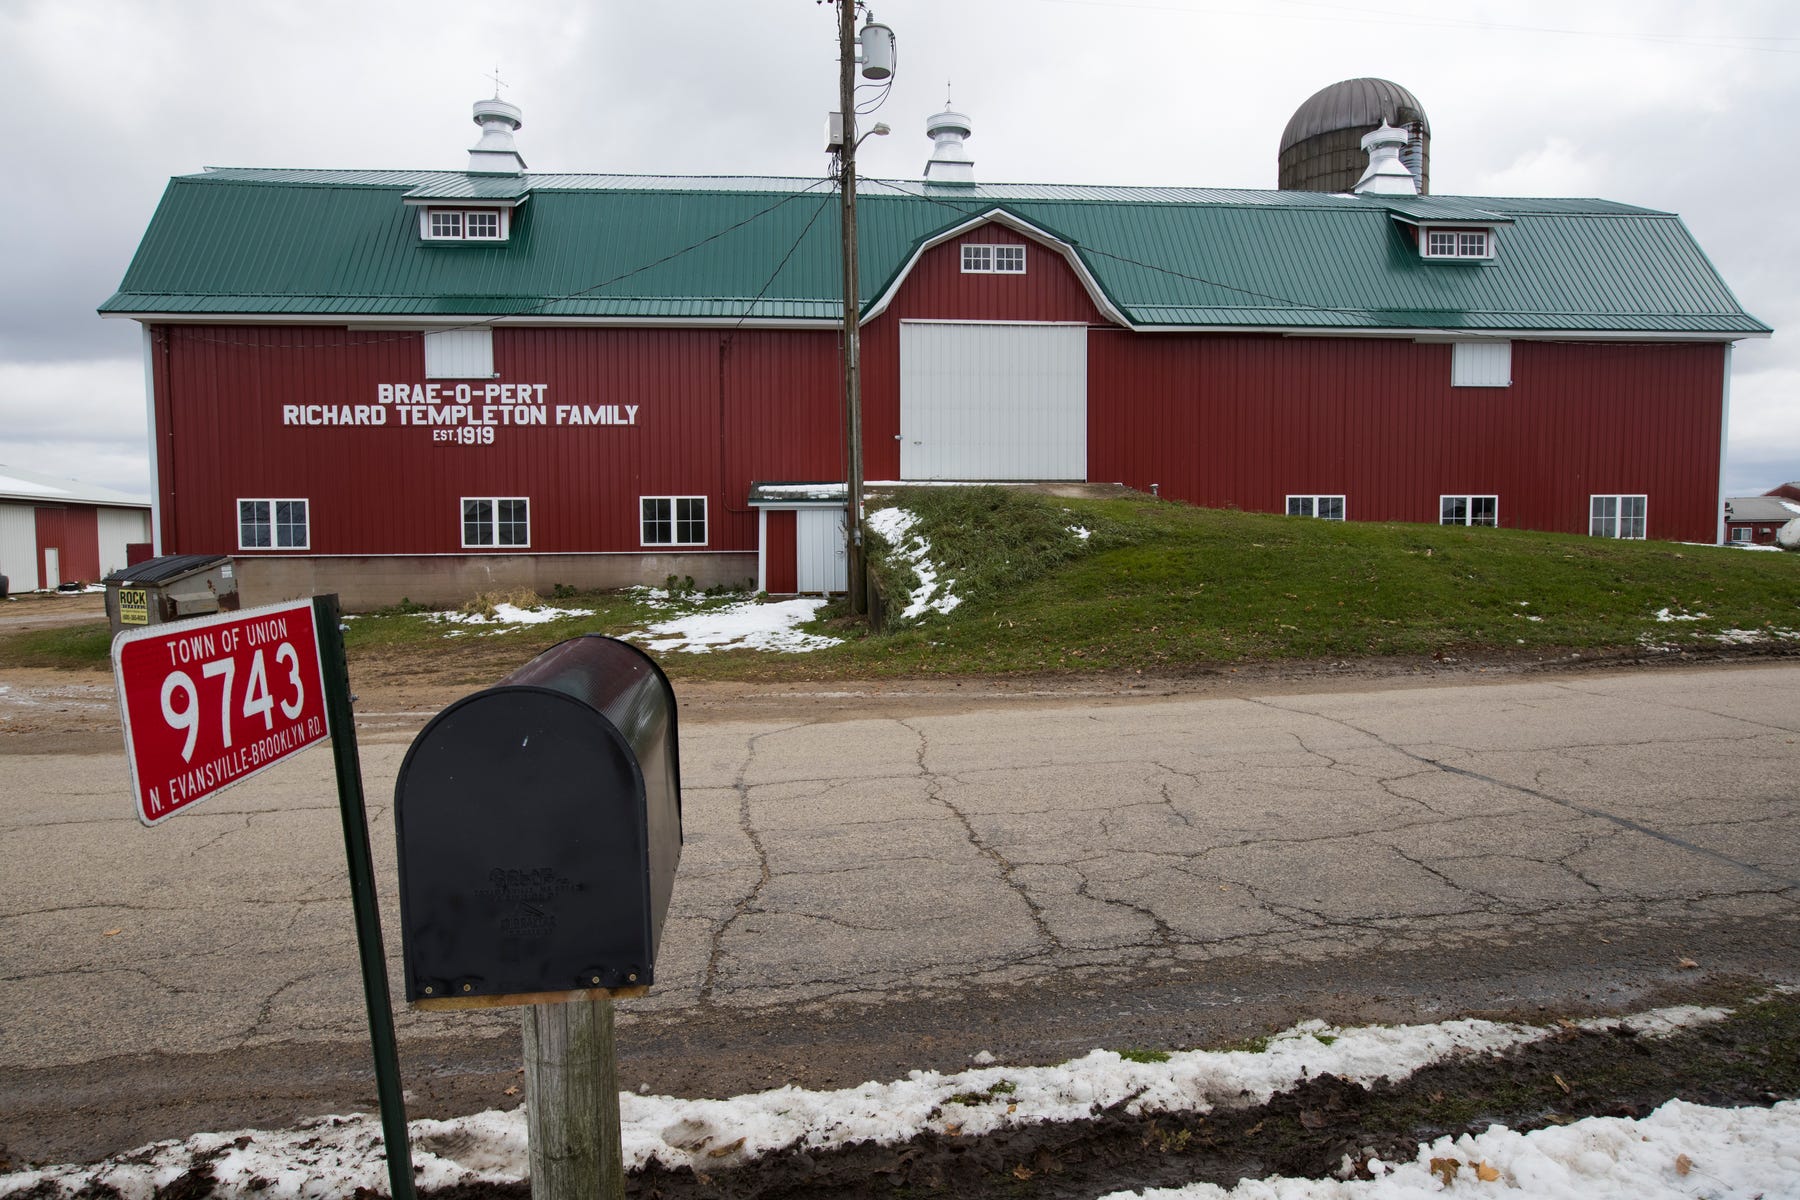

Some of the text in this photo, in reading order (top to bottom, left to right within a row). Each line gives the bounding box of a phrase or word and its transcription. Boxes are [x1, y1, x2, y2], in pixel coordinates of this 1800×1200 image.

[378, 384, 548, 404] BRAE-O-PERT
[283, 405, 639, 425] RICHARD TEMPLETON FAMILY
[120, 591, 146, 605] ROCK
[167, 618, 288, 666] TOWN OF UNION
[160, 642, 304, 764] 9743
[149, 715, 323, 814] N. EVANSVILLE-BROOKLYN RD.
